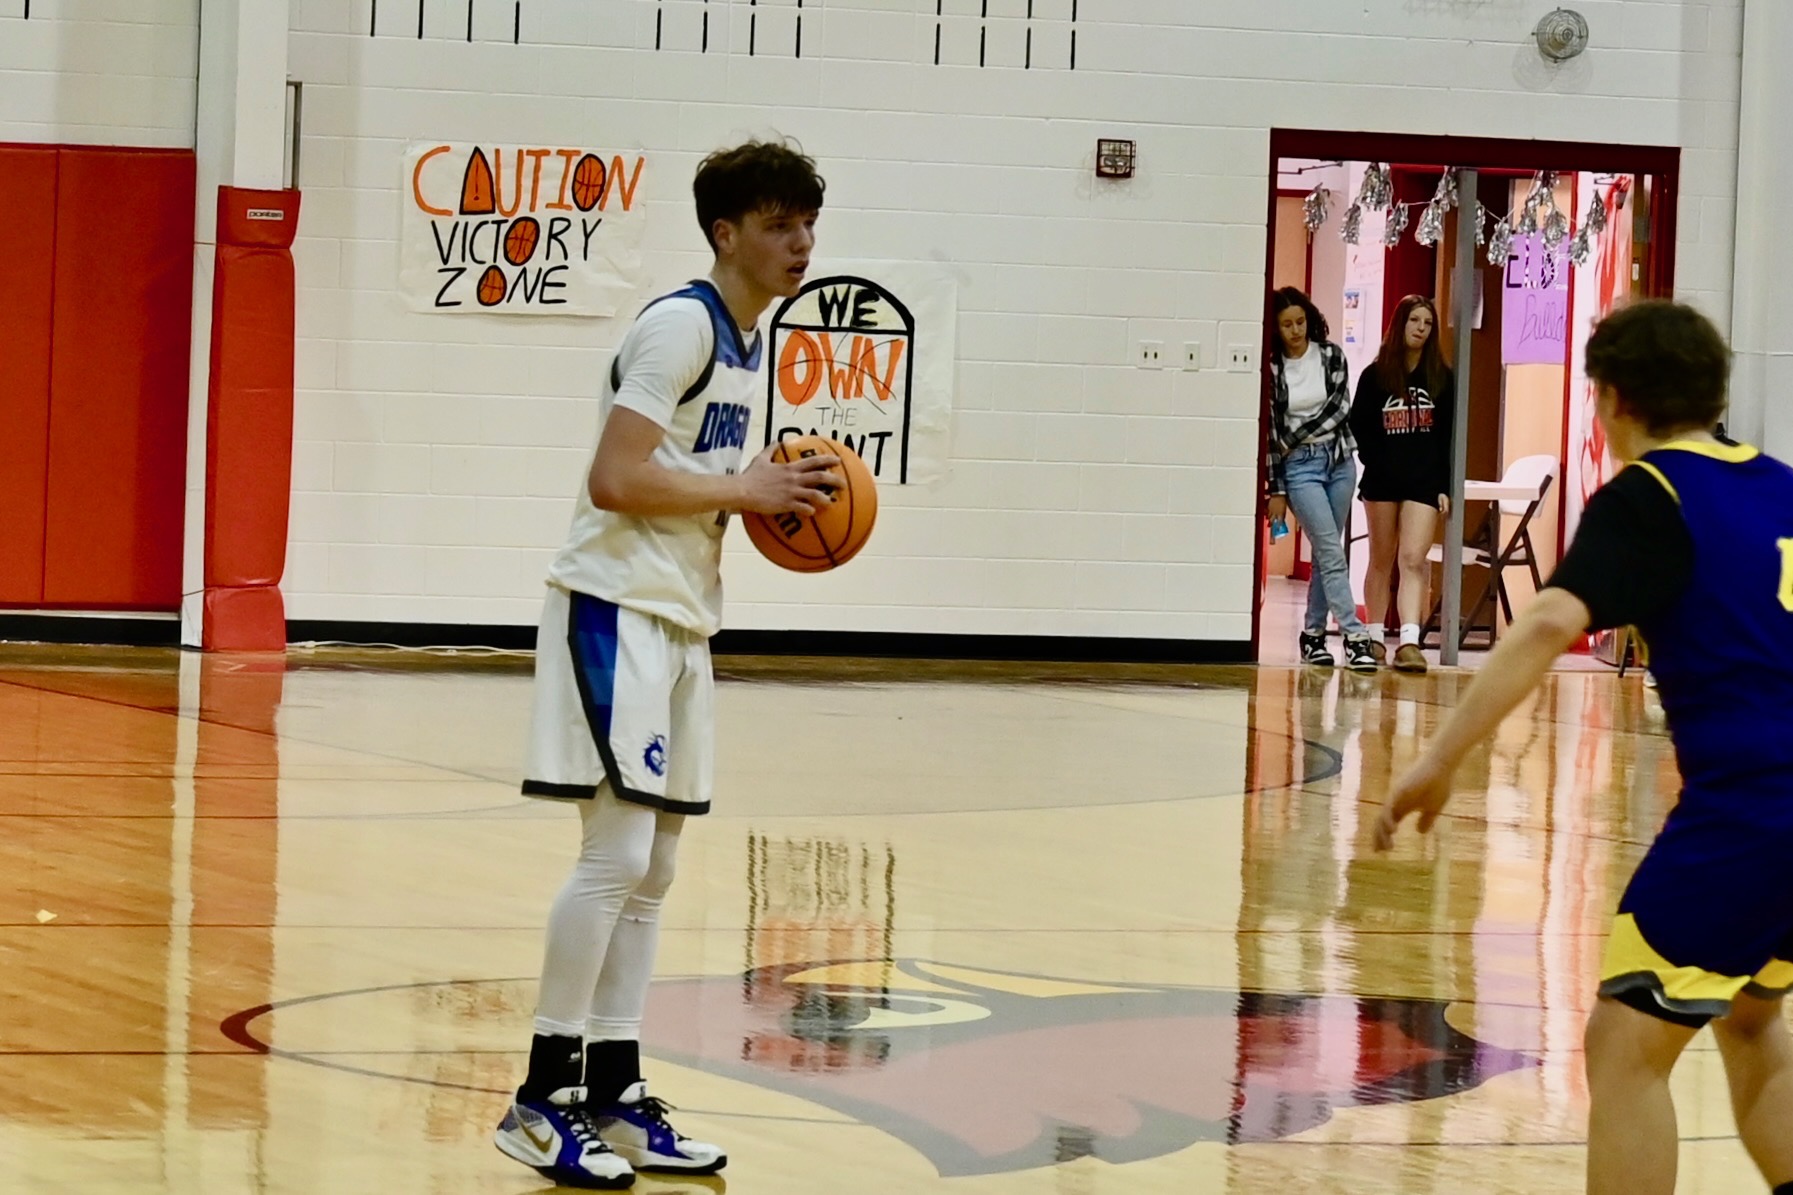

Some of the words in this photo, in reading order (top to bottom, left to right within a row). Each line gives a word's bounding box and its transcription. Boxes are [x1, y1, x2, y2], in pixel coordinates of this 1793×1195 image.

[413, 146, 645, 217] CAUTION
[431, 216, 602, 266] VICTORY
[435, 265, 569, 306] ZONE
[818, 284, 880, 328] WE
[777, 328, 905, 406] OWN
[815, 406, 857, 427] THE
